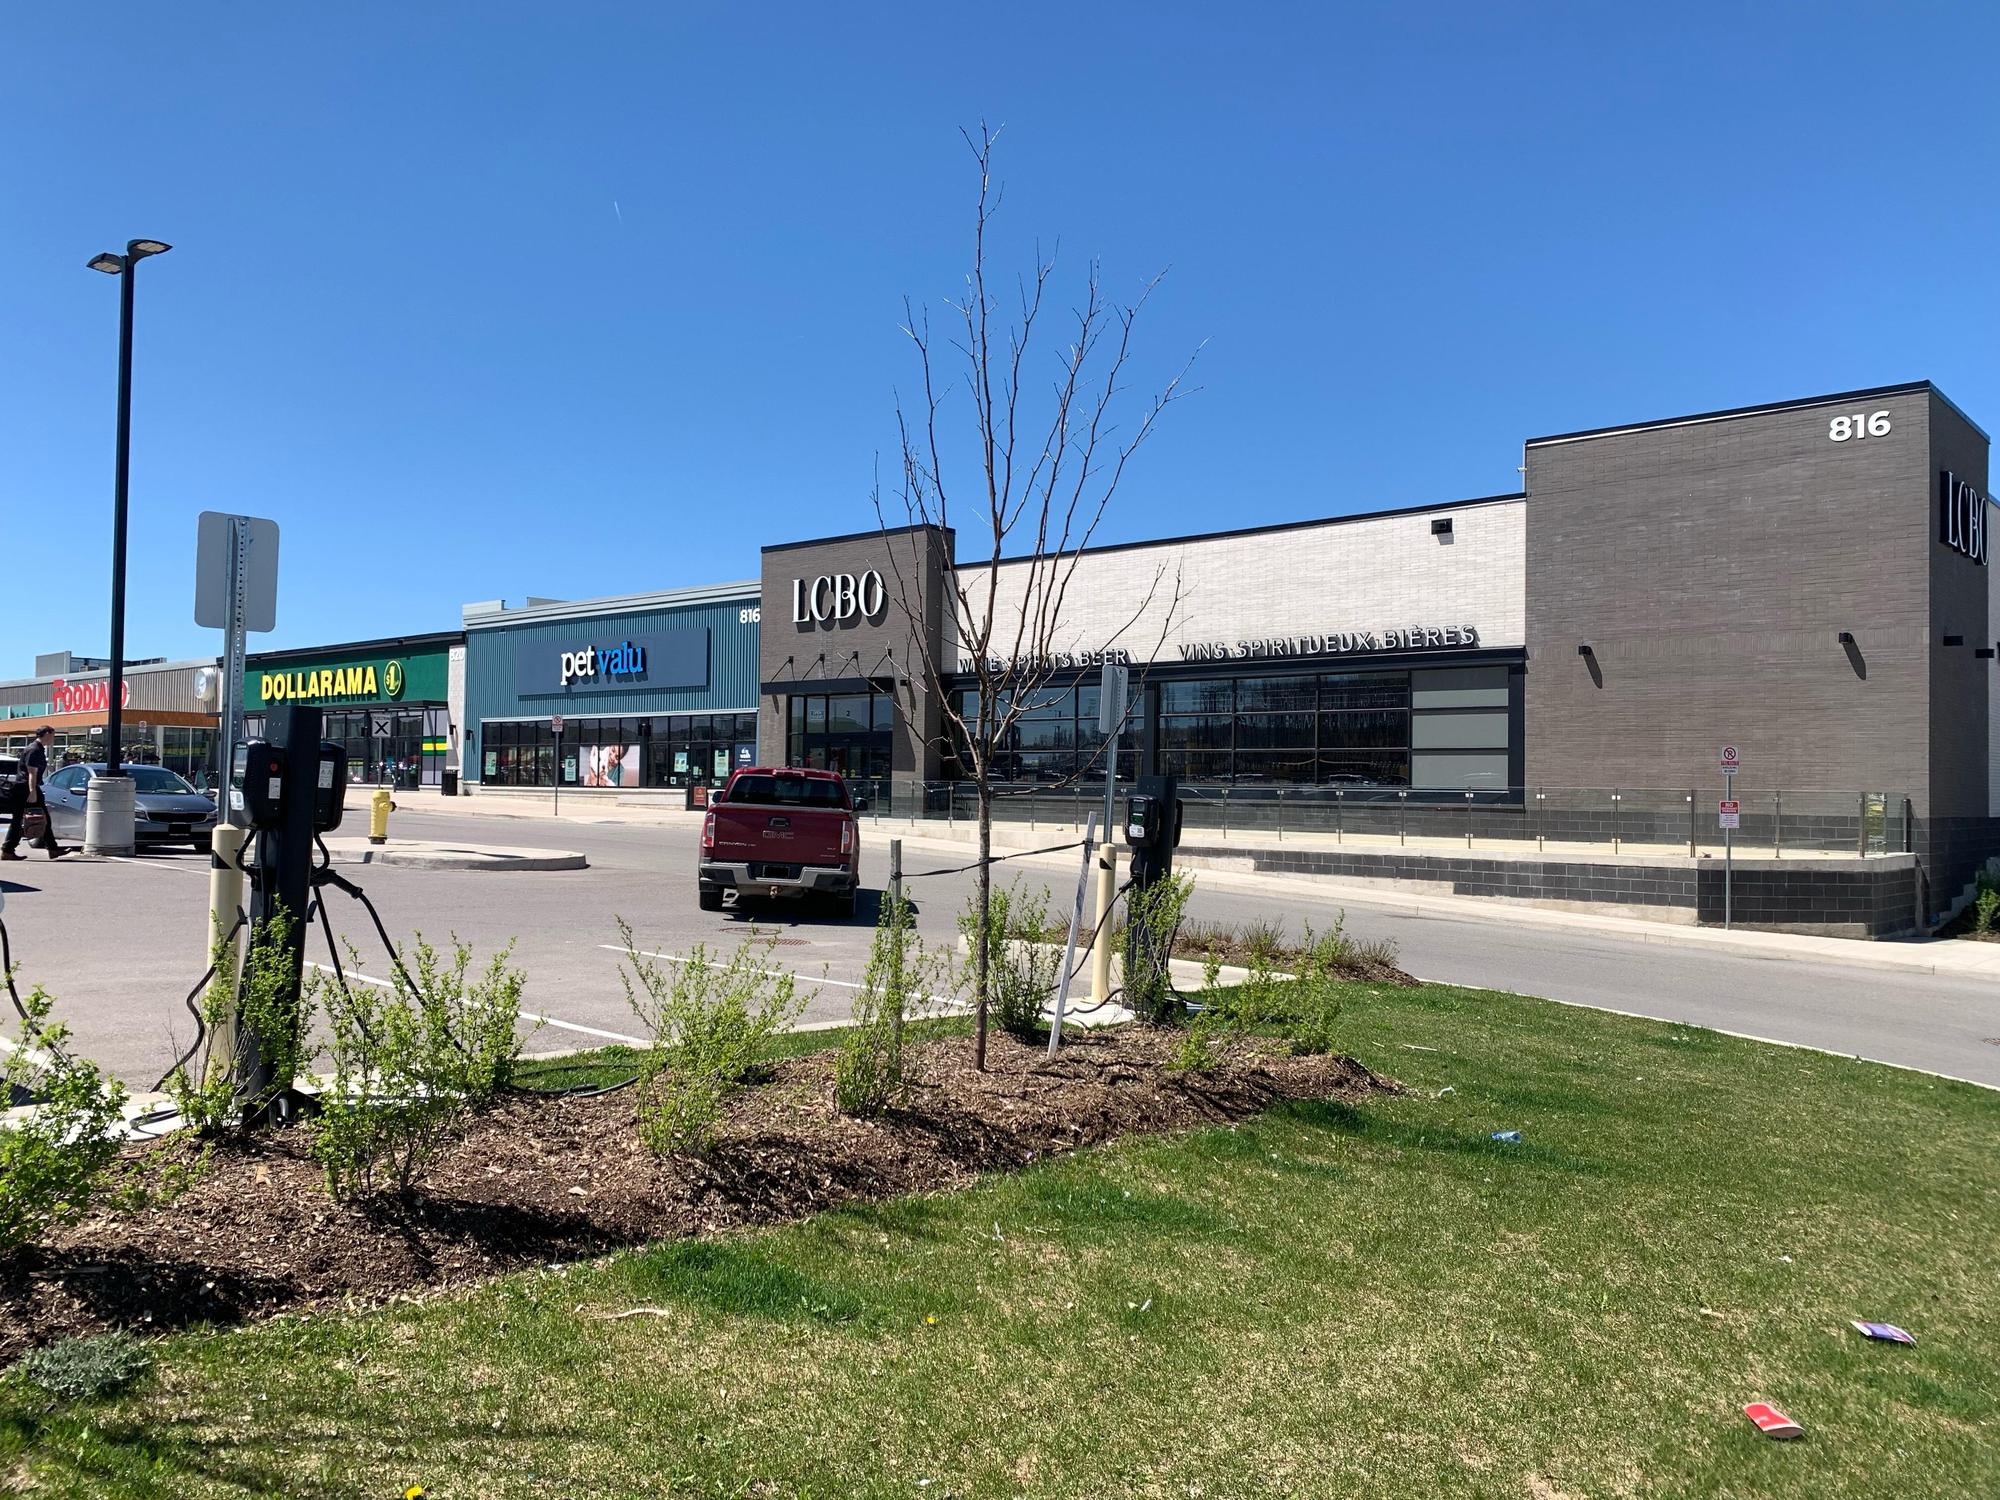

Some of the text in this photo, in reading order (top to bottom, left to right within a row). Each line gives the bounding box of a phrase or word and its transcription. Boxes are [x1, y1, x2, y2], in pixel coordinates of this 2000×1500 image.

[1829, 411, 1891, 442] 816
[1949, 471, 1989, 566] LCBO
[792, 570, 883, 622] LCBO
[740, 608, 761, 623] 816
[1080, 649, 1126, 666] BEER
[1178, 624, 1475, 660] VINS SPIRITUEUX BIÈRES
[53, 679, 130, 713] FOODLAD
[262, 666, 377, 700] DOLLARAMA
